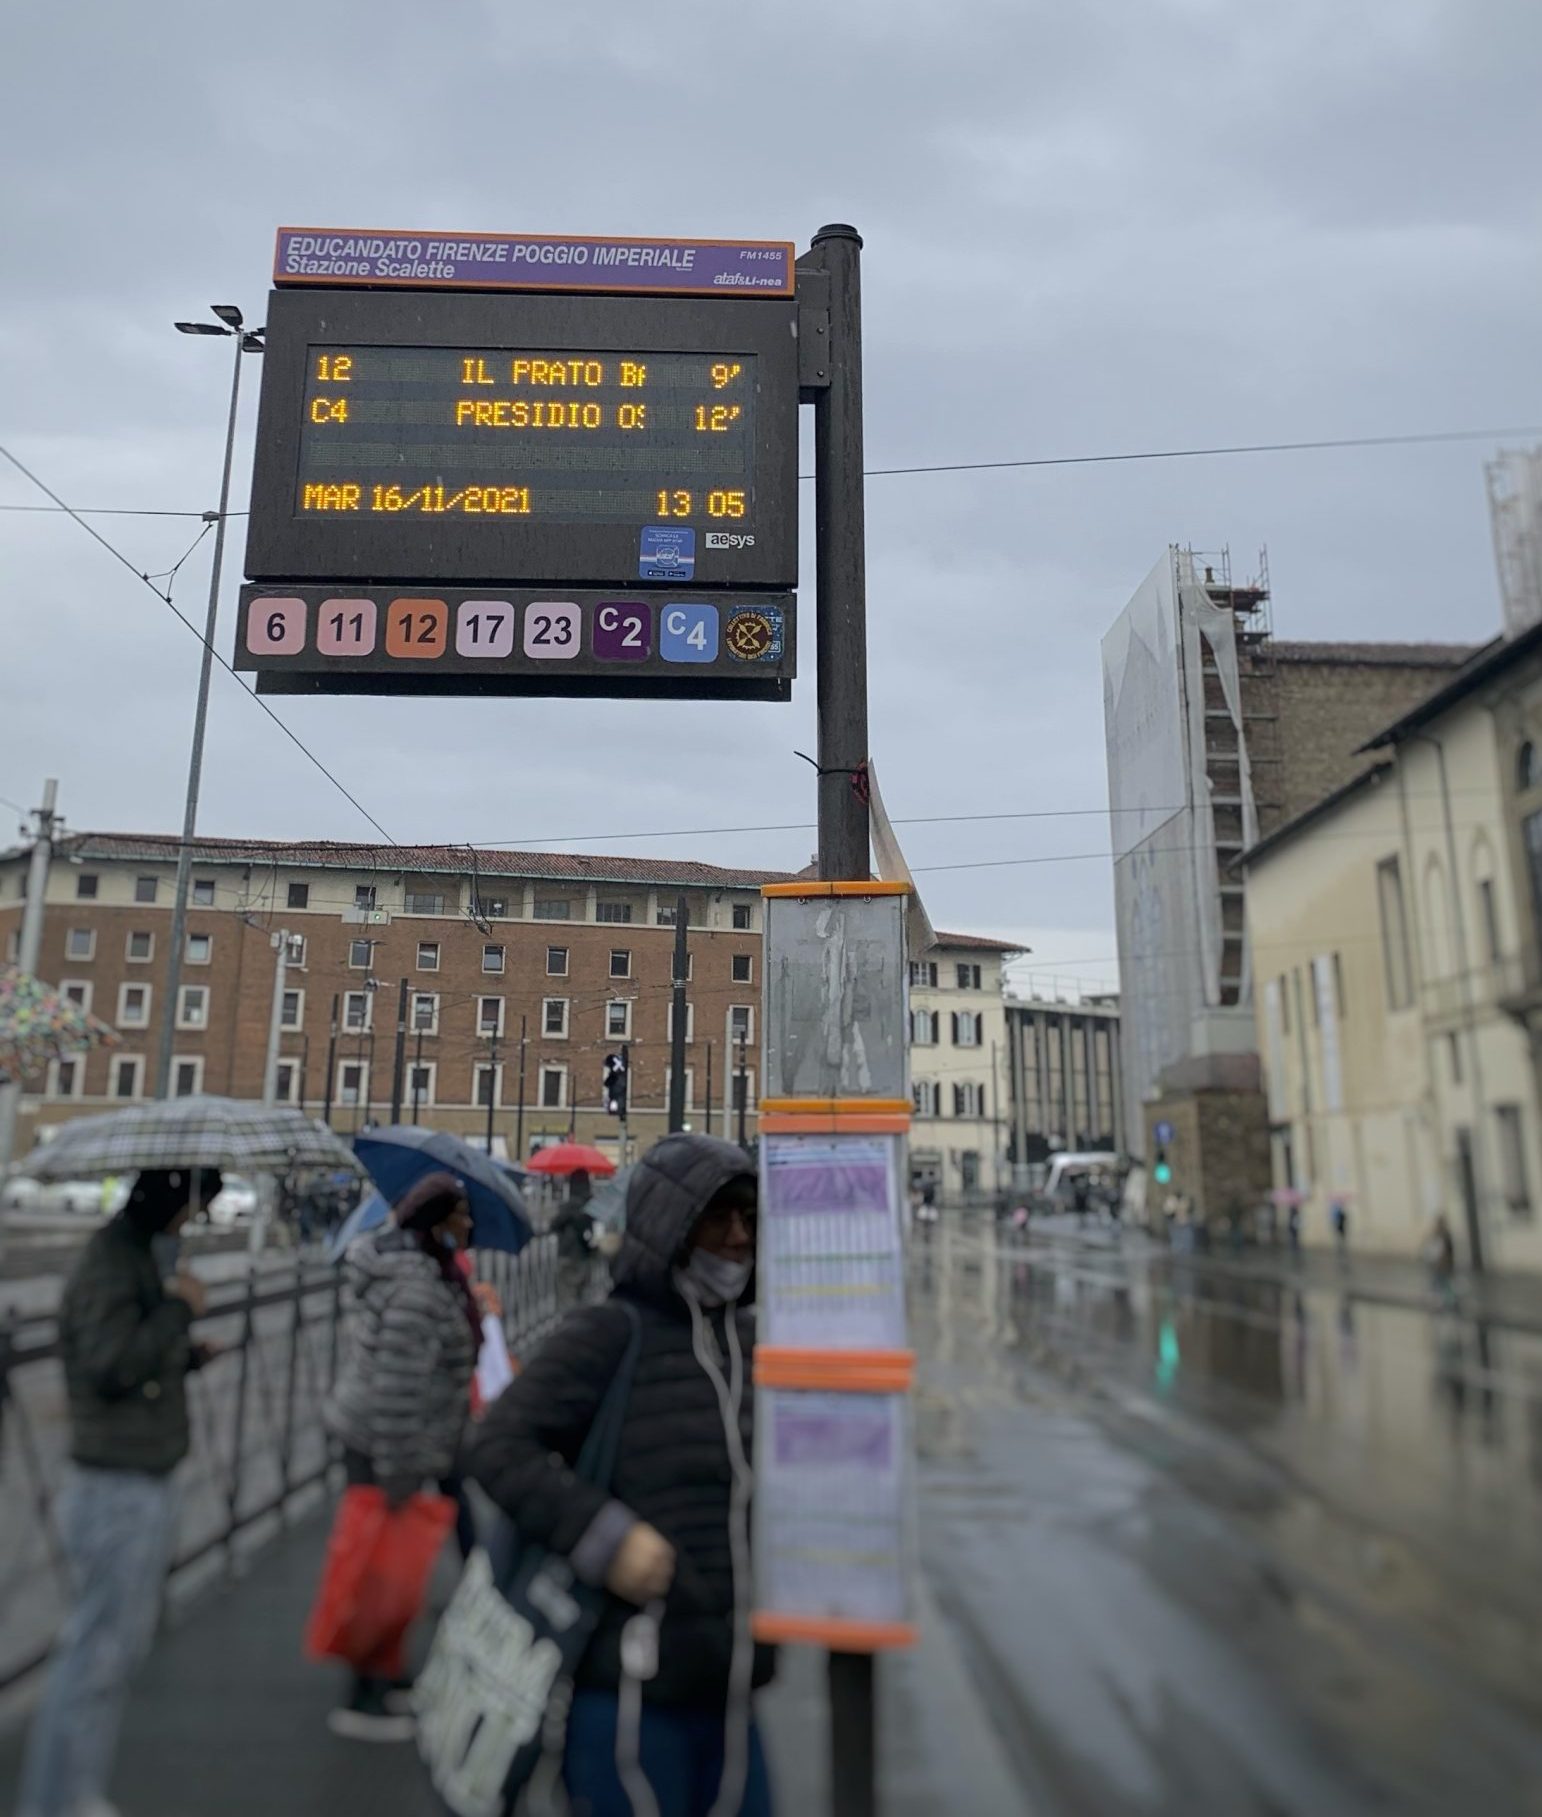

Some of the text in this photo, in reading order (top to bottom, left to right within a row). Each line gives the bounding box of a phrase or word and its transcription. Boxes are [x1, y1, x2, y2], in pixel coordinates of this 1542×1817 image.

[286, 237, 696, 268] EDUCANDATO FIRENZE POGGIO IMPERIALE
[286, 255, 456, 279] Stazione Scalette
[739, 251, 782, 261] FM1455
[317, 356, 352, 381] 12
[462, 359, 495, 384] IL
[512, 360, 602, 386] PRATO
[311, 399, 348, 423] C4
[456, 401, 601, 428] PRESIDIO
[303, 484, 745, 518] MAR 16/11/2021 13 05
[710, 533, 756, 549] aesys
[266, 612, 286, 642] 6
[330, 612, 363, 642] 11
[398, 613, 438, 644] 12
[466, 614, 505, 644] 17
[532, 615, 572, 645] 23
